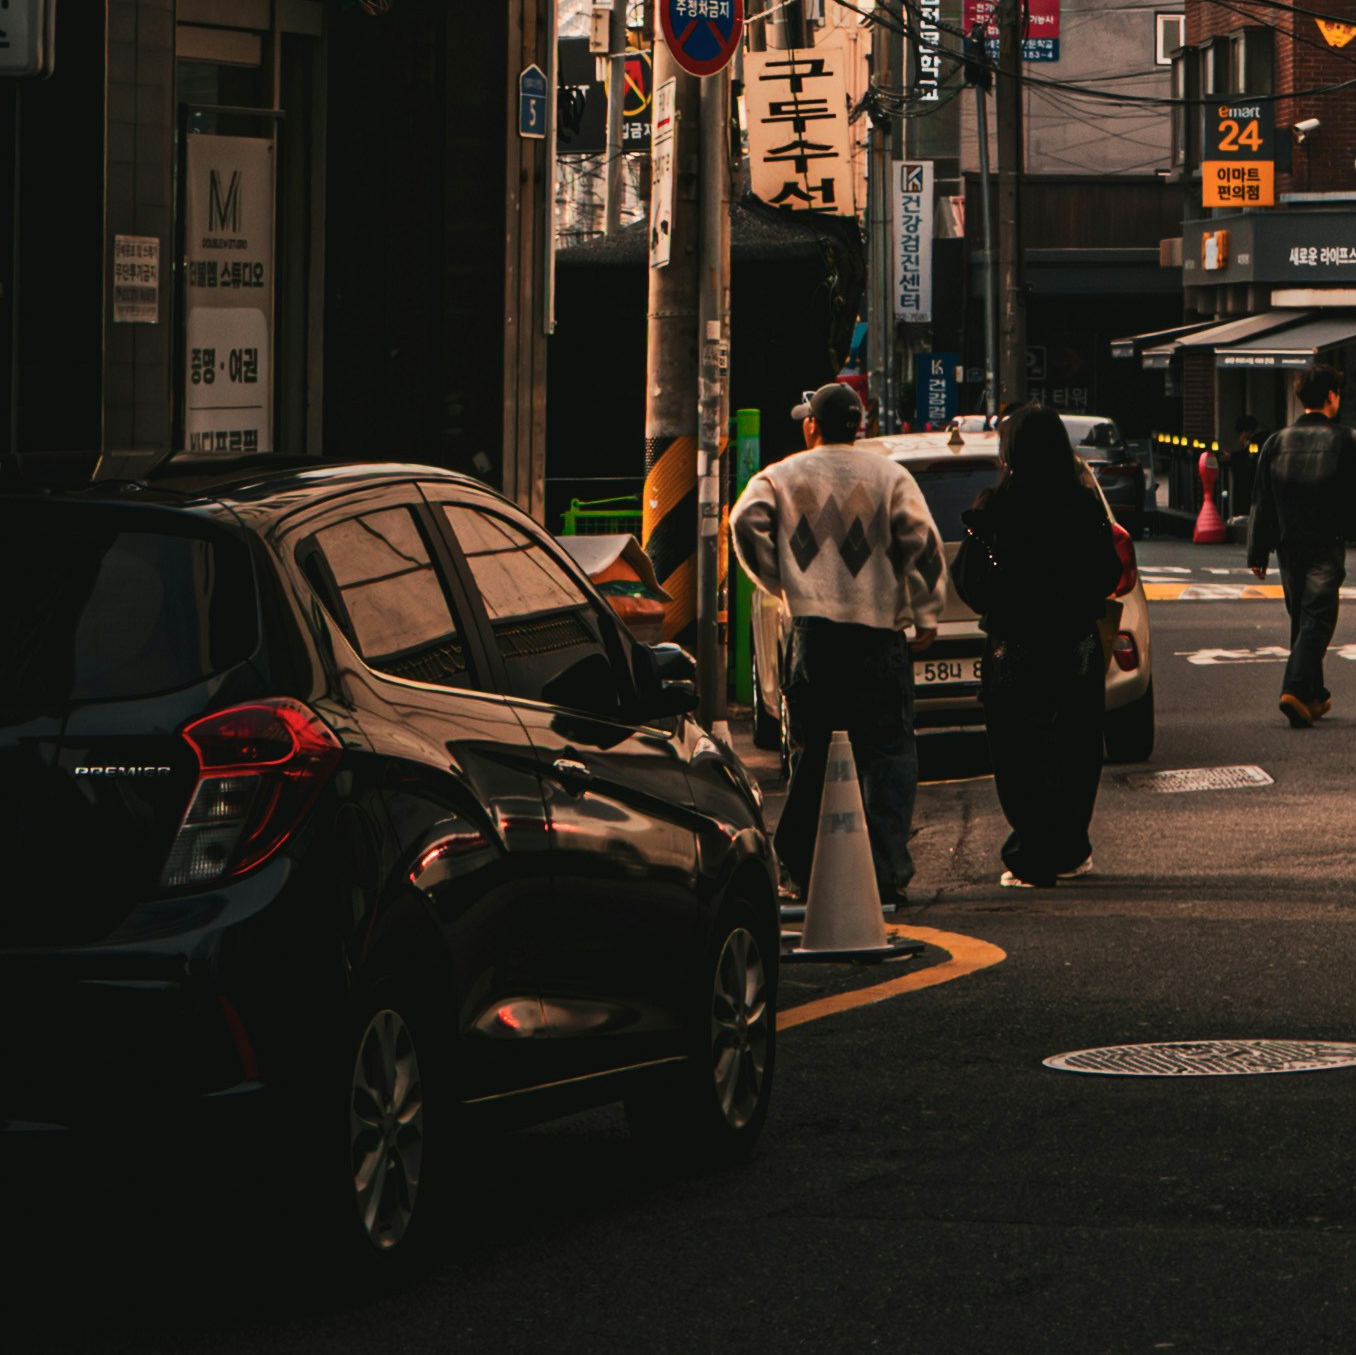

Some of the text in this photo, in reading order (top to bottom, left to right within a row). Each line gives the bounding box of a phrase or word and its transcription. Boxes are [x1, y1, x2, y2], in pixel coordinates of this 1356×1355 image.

[1218, 104, 1261, 119] emart
[759, 58, 839, 213] 구두수선
[1218, 120, 1264, 152] 24
[1217, 167, 1261, 183] 이마트
[1217, 185, 1260, 201] 편의점
[900, 195, 922, 311] 건강검진센터
[1289, 247, 1317, 266] 새로운
[221, 261, 264, 288] 스튜디오
[191, 348, 258, 385] 증명 여권
[928, 378, 947, 424] 건강검
[73, 765, 172, 778] PREMIER
